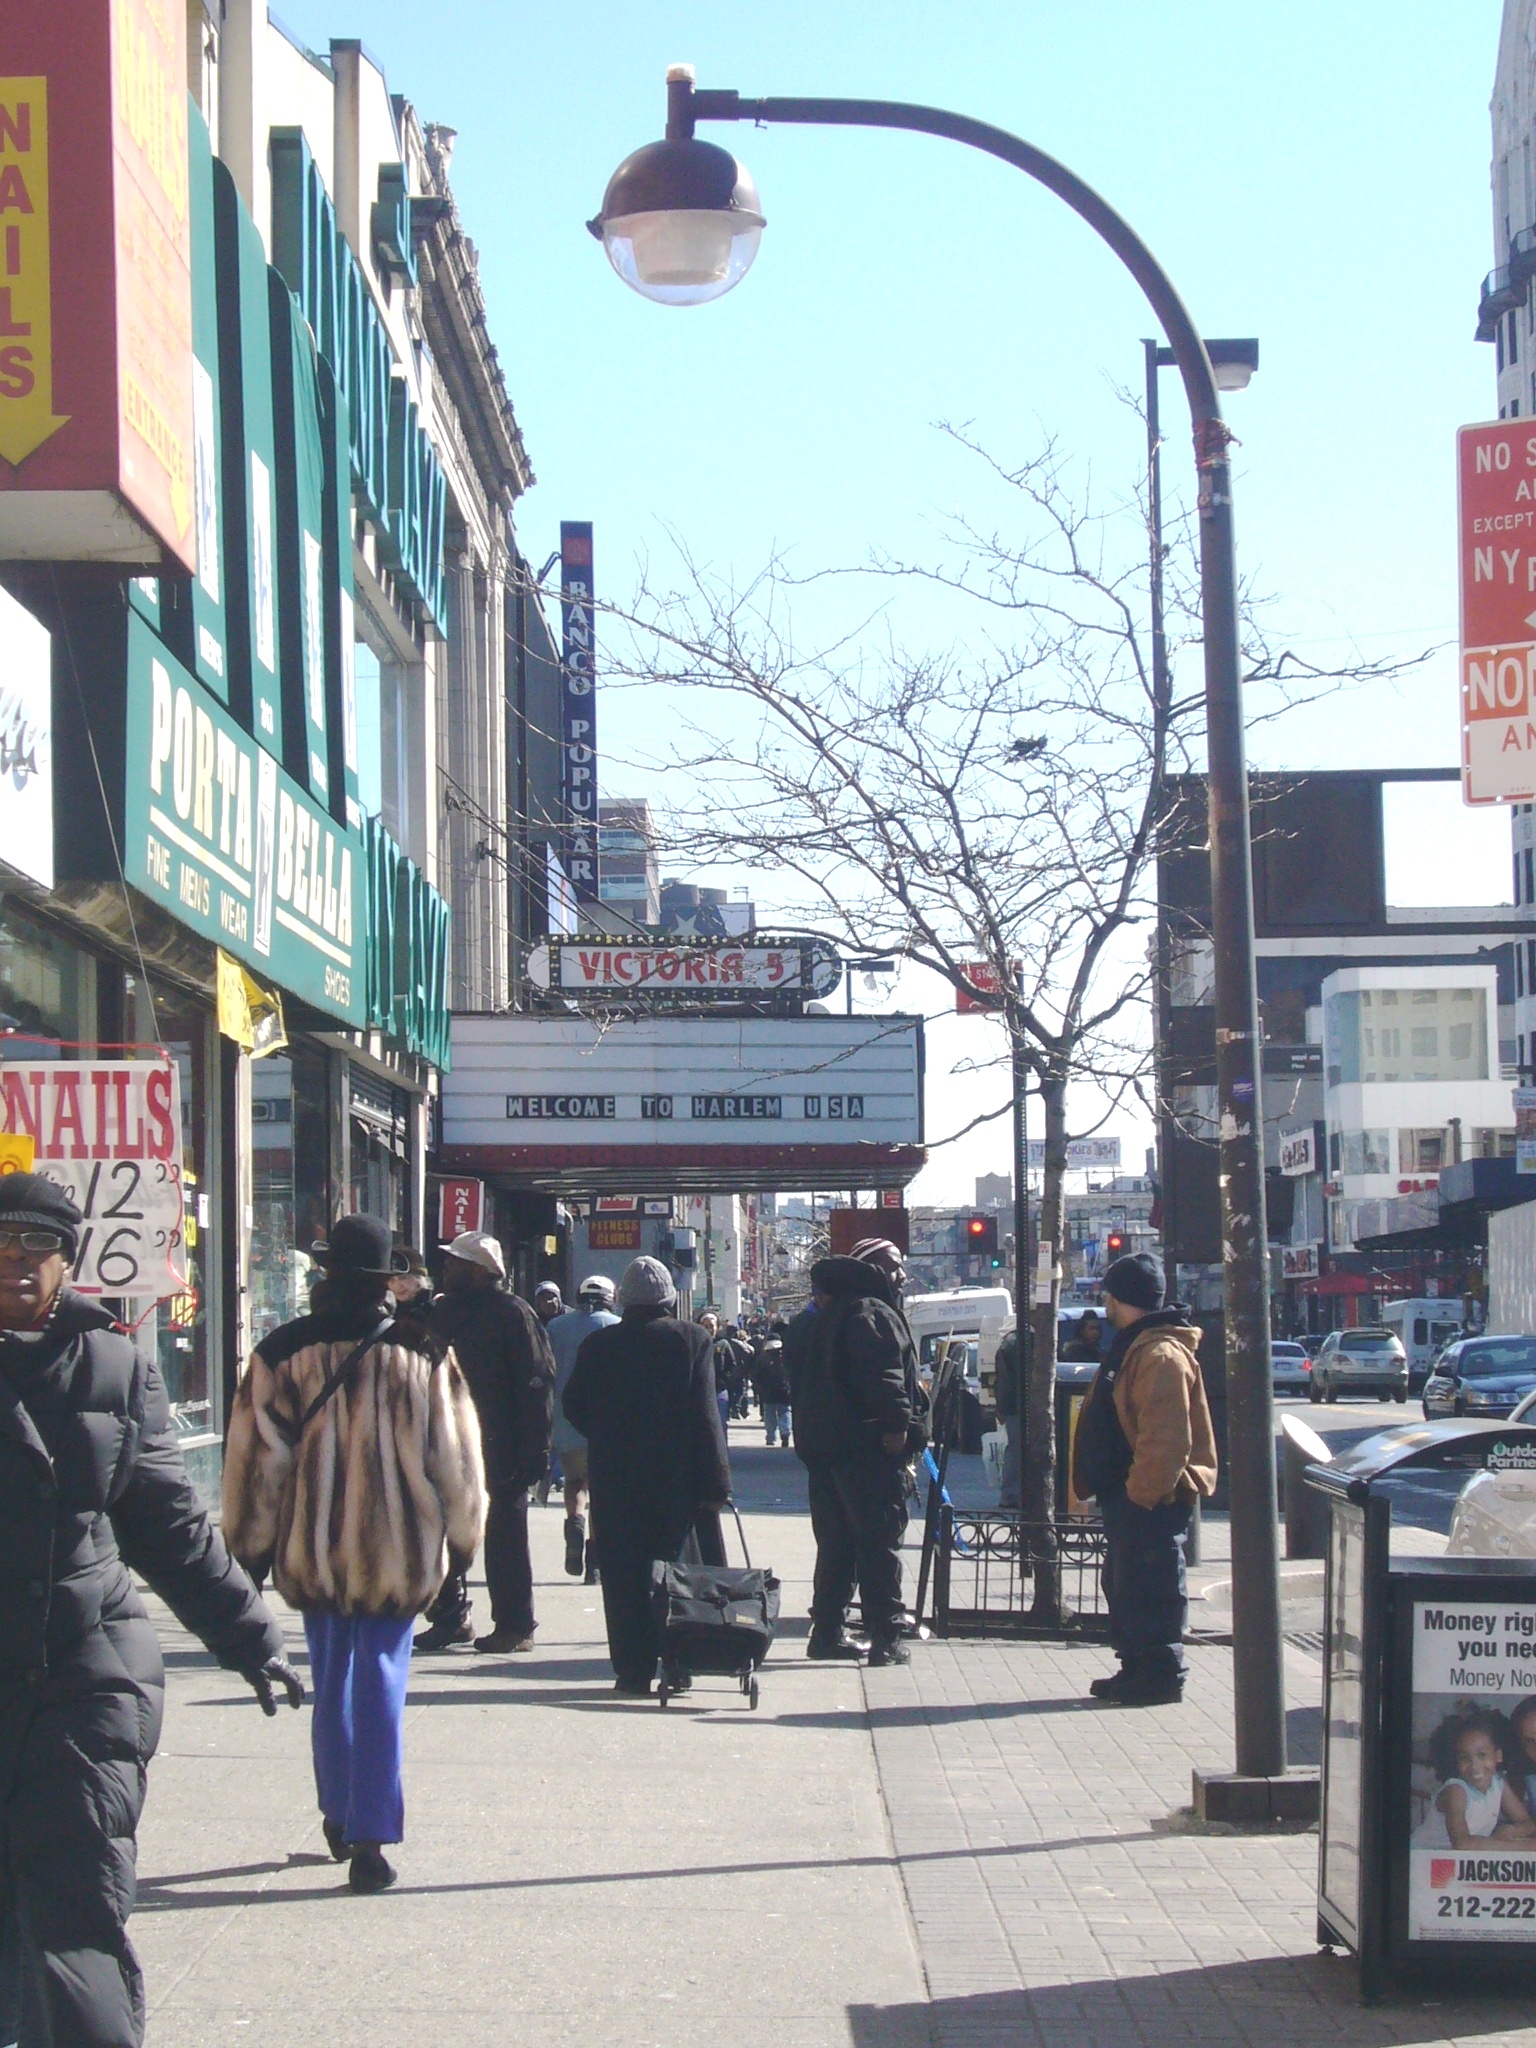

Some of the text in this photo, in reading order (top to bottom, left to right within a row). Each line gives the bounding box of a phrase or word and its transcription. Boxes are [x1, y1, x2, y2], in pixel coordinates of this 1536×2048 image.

[0, 103, 35, 398] NAILS
[127, 374, 184, 484] ENTRANCE
[1475, 442, 1511, 474] NO
[1515, 477, 1536, 502] A
[1473, 511, 1535, 534] EXCEPT
[567, 581, 592, 696] BANCO
[1469, 656, 1524, 711] NO
[150, 657, 252, 872] PORTA
[277, 788, 352, 947] BELLA
[568, 719, 594, 881] POPULAR
[147, 834, 171, 890] FINE
[220, 890, 248, 943] WEAR
[324, 965, 350, 1008] SHOES
[578, 951, 784, 985] VICTORIA 5
[2, 1069, 175, 1161] NAILS
[507, 1098, 615, 1118] WELCOME
[643, 1098, 673, 1118] TO
[692, 1098, 781, 1118] HARLEM
[454, 1187, 470, 1233] NAILS
[1424, 1609, 1536, 1637] Money rig
[1458, 1641, 1497, 1661] you
[1450, 1667, 1536, 1691] Money No
[1457, 1859, 1536, 1883] JACKSON
[1438, 1895, 1536, 1919] 212-222
